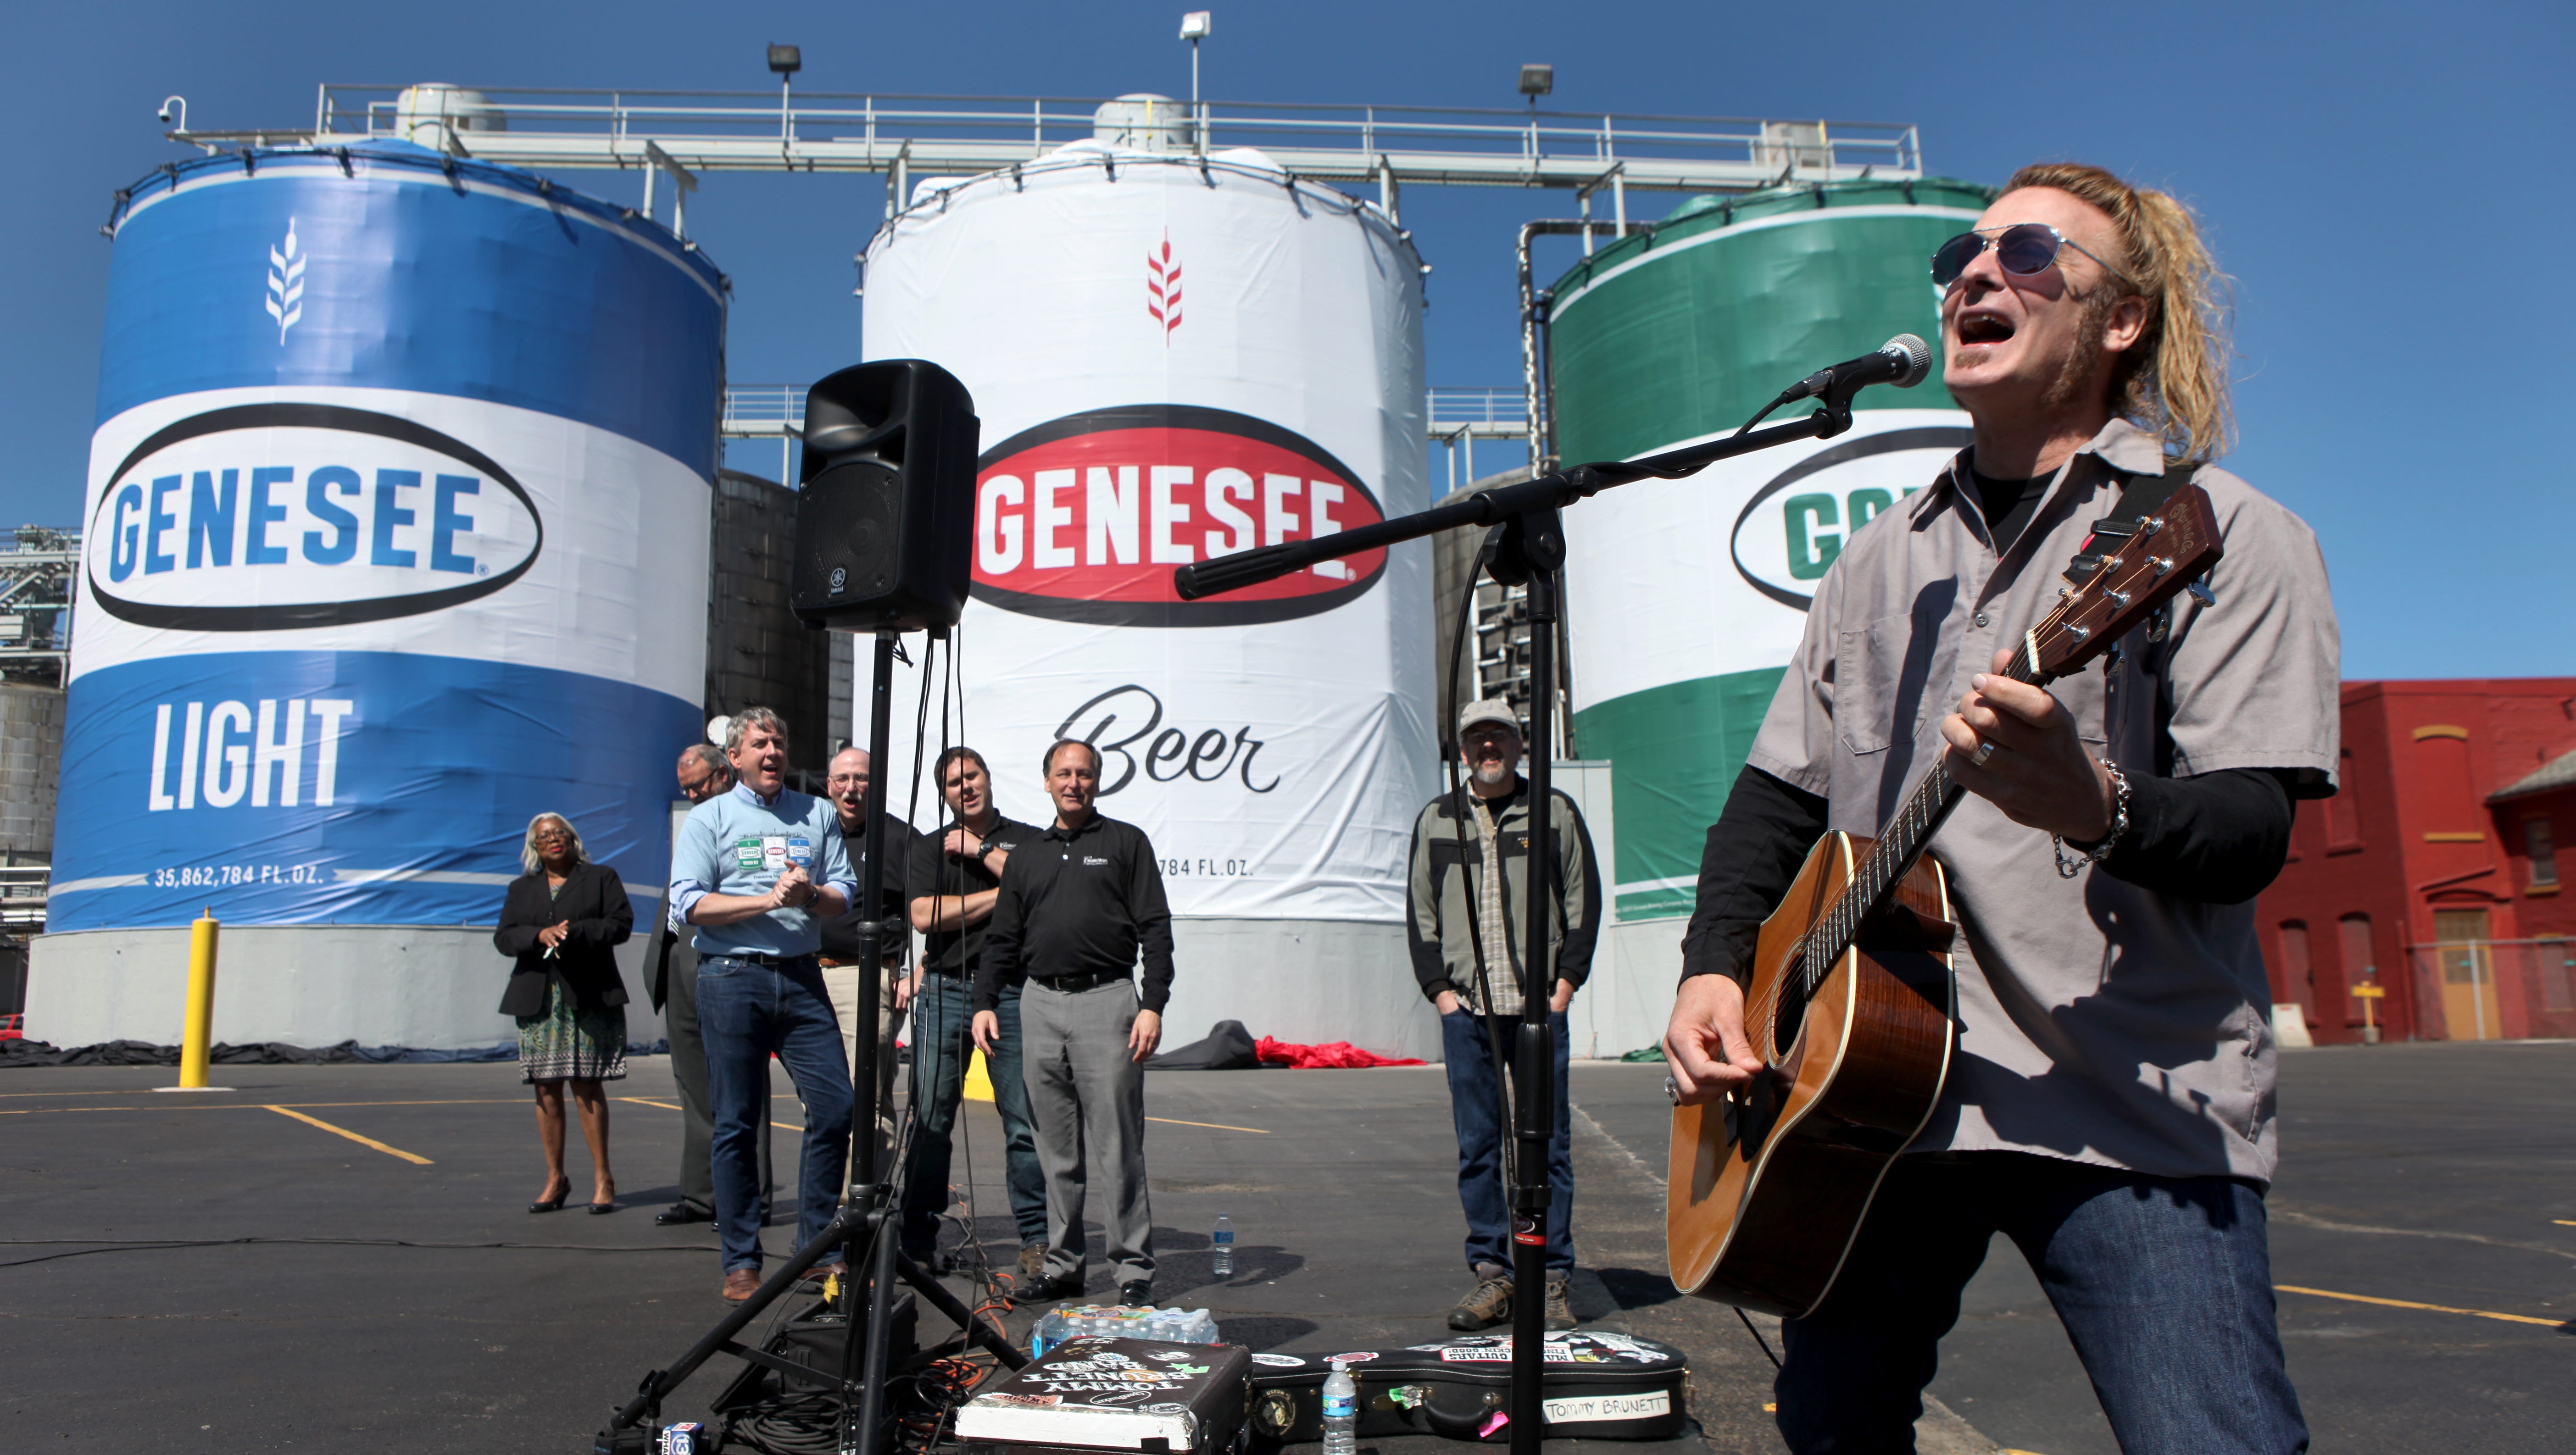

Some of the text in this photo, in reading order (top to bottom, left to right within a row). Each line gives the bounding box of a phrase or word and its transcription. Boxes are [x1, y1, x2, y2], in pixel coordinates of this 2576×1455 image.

[109, 465, 480, 583] GENESEE
[979, 465, 1346, 580] GENESEE
[1054, 684, 1280, 797] Beer
[149, 699, 353, 811] LIGHT
[155, 866, 253, 888] 35,862,784
[1022, 1372, 1194, 1382] BRUNETT
[1043, 1361, 1147, 1372] BAND
[1044, 1381, 1184, 1393] TOMMY
[1546, 1396, 1669, 1418] TOMMY BRUNETT
[676, 1437, 689, 1455] 13
